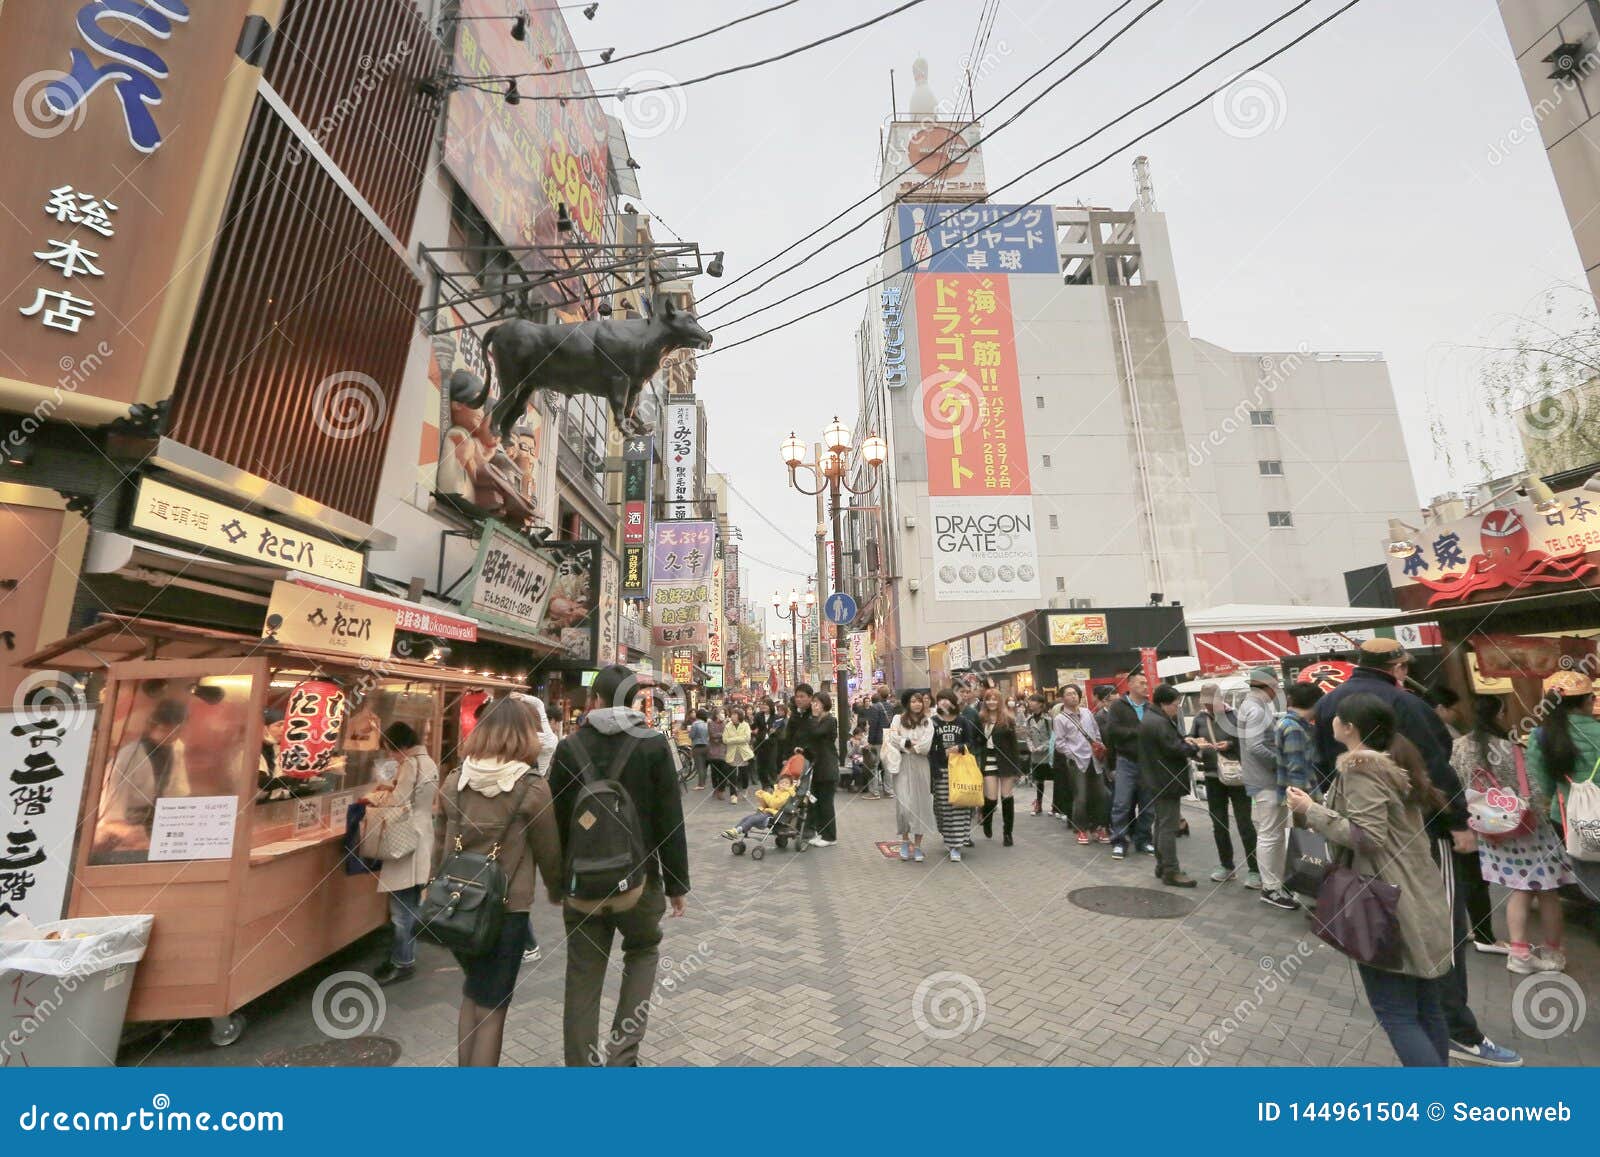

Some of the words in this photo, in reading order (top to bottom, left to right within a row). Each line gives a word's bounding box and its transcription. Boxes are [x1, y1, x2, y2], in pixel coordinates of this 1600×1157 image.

[938, 208, 1042, 228] ボウリング
[940, 230, 1043, 248] ビリヤード
[19, 184, 119, 334] 総本店
[967, 250, 1022, 270] 卓球
[881, 288, 907, 388] ボウリング
[933, 279, 974, 489] ドラゴンゲート
[629, 512, 641, 524] 酒
[936, 515, 1031, 533] DRAGON
[150, 497, 209, 531] 道頓堀
[258, 527, 314, 567] たこ八
[660, 528, 710, 545] 天ぷら
[938, 534, 996, 552] GATE
[664, 549, 703, 573] 久幸
[395, 609, 430, 632] お好み焼
[281, 689, 321, 771] たこ焼
